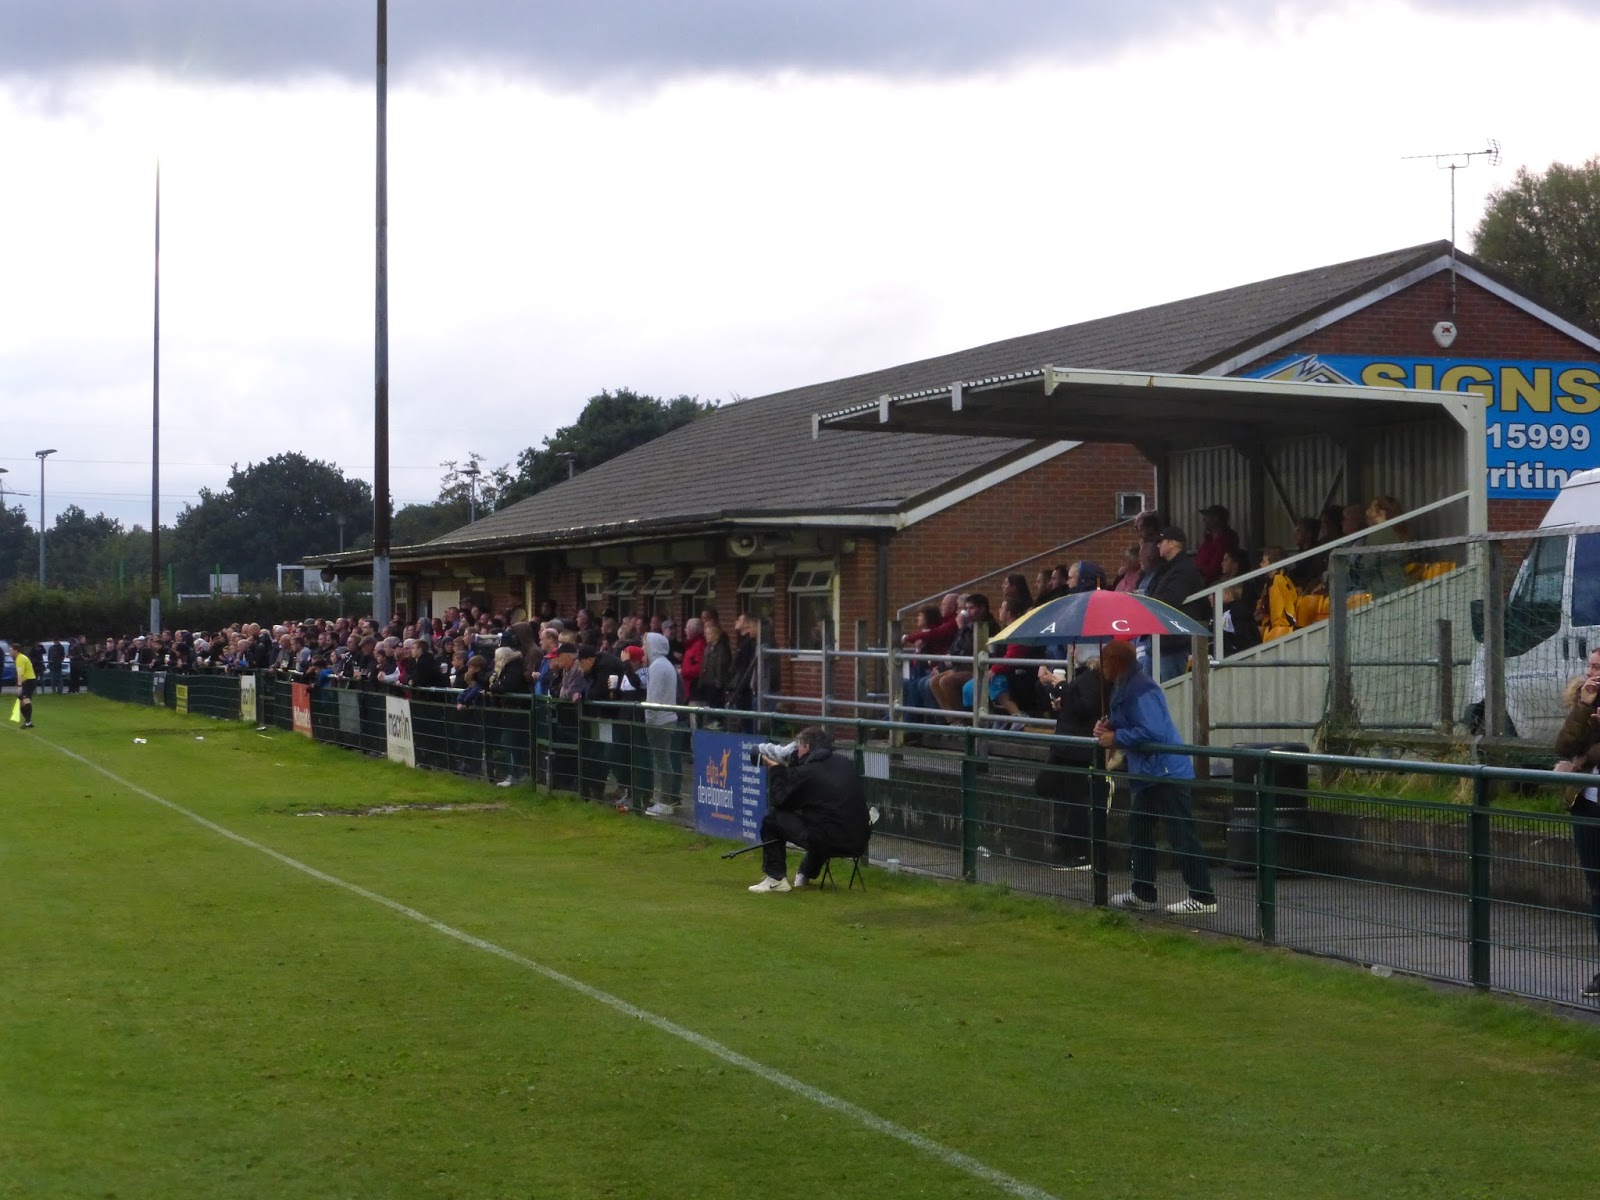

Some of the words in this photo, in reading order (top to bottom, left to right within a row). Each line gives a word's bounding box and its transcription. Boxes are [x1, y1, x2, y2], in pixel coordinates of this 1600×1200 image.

[1360, 362, 1600, 414] SIGNS
[1486, 422, 1590, 450] 15999
[1486, 461, 1587, 489] ritin
[1111, 619, 1131, 632] C
[697, 776, 734, 812] development
